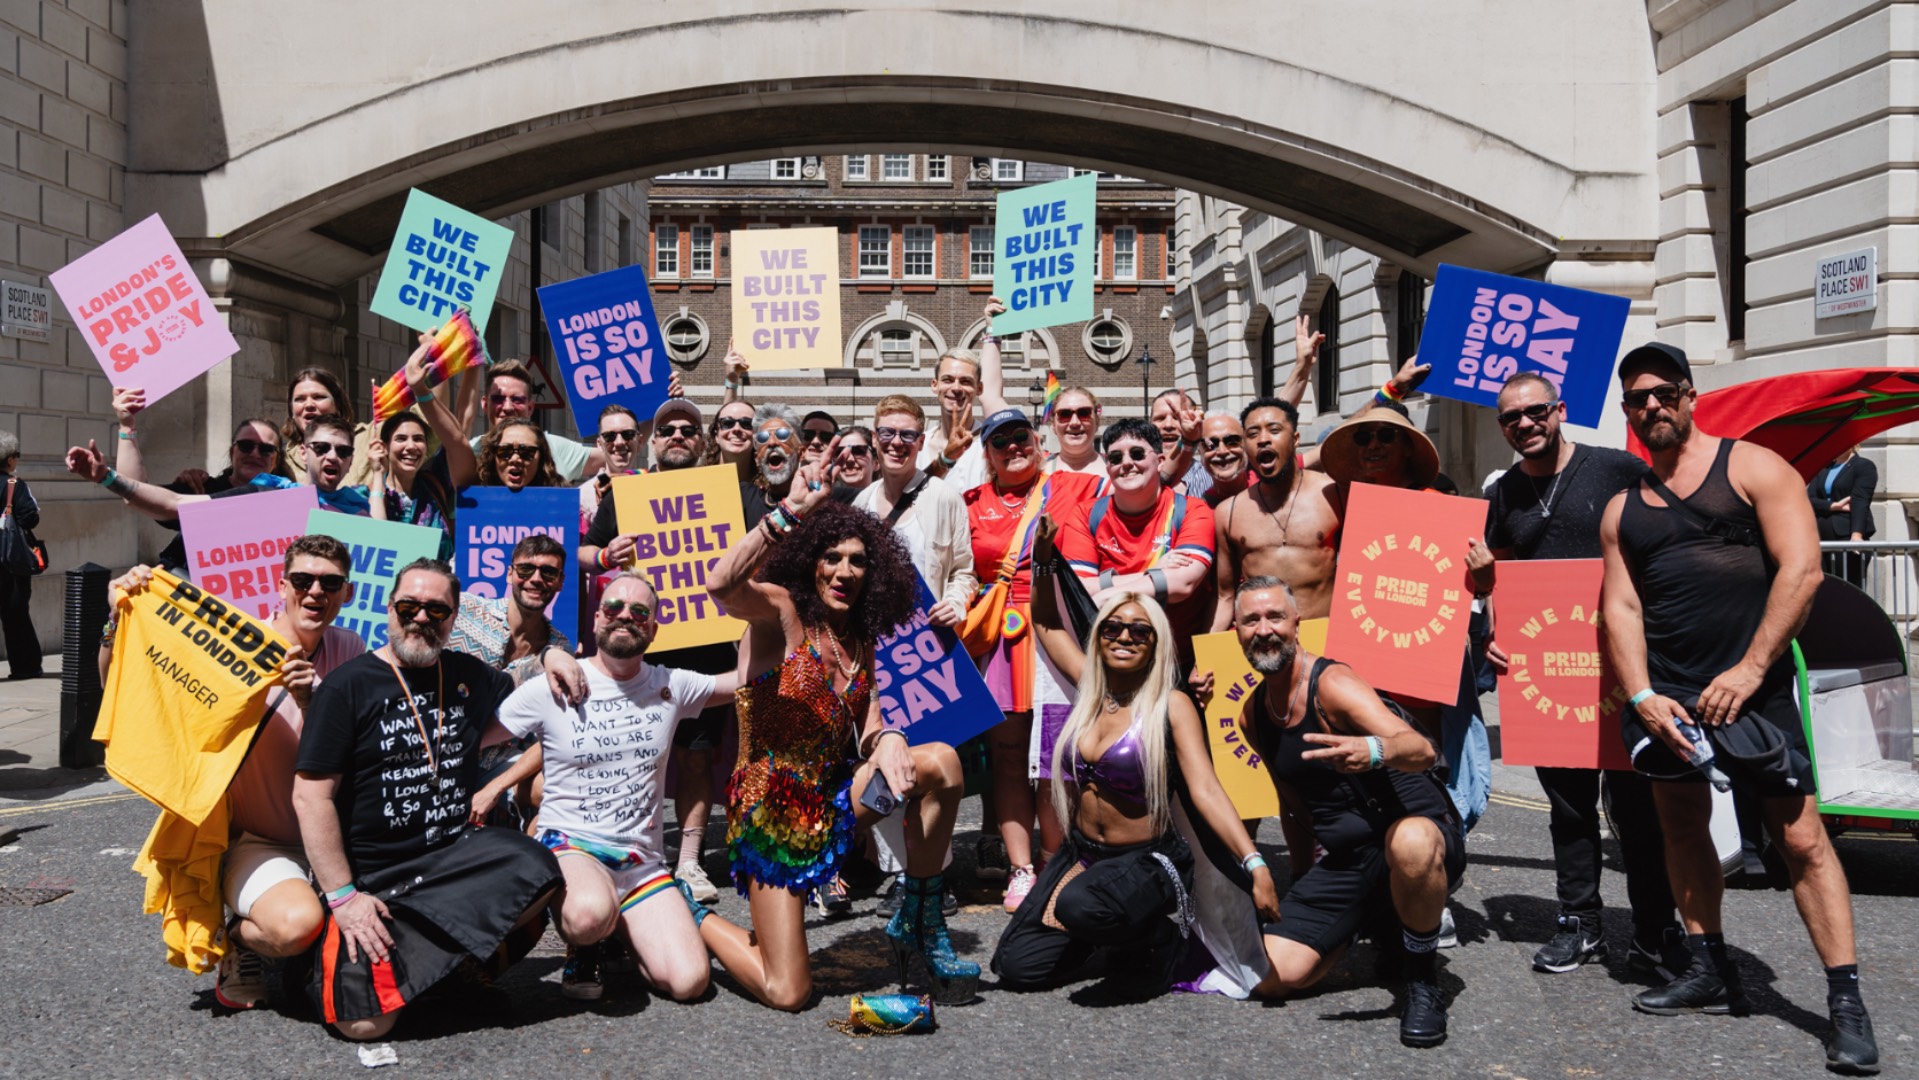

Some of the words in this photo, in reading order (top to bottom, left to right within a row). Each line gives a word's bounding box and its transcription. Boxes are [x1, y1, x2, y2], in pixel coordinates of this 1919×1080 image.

[1023, 200, 1066, 228] WE
[433, 217, 480, 254] WE
[1005, 223, 1083, 258] BU!LT
[405, 233, 491, 282] BU!LT
[760, 248, 808, 270] WE
[1011, 252, 1075, 284] THIS
[1821, 255, 1867, 279] SCOTLAND
[78, 254, 177, 320] LONDON'S
[408, 258, 475, 303] THIS
[743, 274, 827, 297] BU!LT
[1011, 279, 1074, 311] CITY
[1821, 278, 1848, 298] PLACE
[1849, 273, 1869, 293] SW1
[8, 287, 47, 308] SCOTLAND
[89, 272, 194, 347] PR!DE
[751, 300, 820, 323] THIS
[8, 304, 32, 321] PLACE
[32, 309, 48, 325] SW1
[558, 300, 642, 335] LONDON
[1491, 293, 1533, 348] SO
[564, 333, 600, 365] IS
[604, 320, 649, 354] SO
[752, 327, 821, 350] CITY
[1454, 287, 1498, 388] LONDON
[109, 343, 140, 373] &
[573, 348, 654, 400] GAY
[1478, 354, 1518, 393] IS
[649, 493, 707, 524] WE
[635, 523, 731, 560] BU!LT
[1362, 534, 1398, 560] WE
[1407, 535, 1452, 574] ARE
[341, 543, 397, 578] WE
[468, 548, 505, 578] IS
[1374, 589, 1386, 600] IN
[1386, 592, 1428, 608] LONDON
[1376, 575, 1429, 599] PR!DE
[1346, 572, 1460, 648] EVERYWHERE
[1520, 607, 1559, 639] WE
[1570, 604, 1606, 629] AR
[170, 581, 287, 673] PR!DE
[155, 601, 185, 626] IN
[181, 620, 262, 687] LONDON
[891, 630, 945, 676] SO
[1543, 652, 1603, 668] PR!DE
[1544, 668, 1556, 677] IN
[1558, 667, 1604, 677] LONDON
[145, 645, 219, 710] MANAGER
[1225, 672, 1258, 702] WE
[397, 691, 435, 711] JUST
[590, 699, 631, 712] JUST
[879, 658, 963, 731] GAY
[380, 737, 396, 751] IF
[402, 732, 426, 747] YOU
[433, 724, 458, 740] ARE
[572, 718, 615, 733] WANT
[646, 712, 663, 724] SAY
[383, 749, 429, 762] TRANS
[441, 742, 463, 754] AND
[572, 738, 585, 749] IF
[594, 735, 620, 748] YOU
[626, 730, 653, 744] ARE
[574, 751, 623, 765] TRANS
[633, 748, 659, 759] AND
[577, 768, 630, 780] READING
[588, 786, 621, 795] LOVE
[627, 782, 646, 795] YOU
[382, 787, 387, 798] I
[395, 783, 429, 798] LOVE
[383, 802, 395, 817] &
[390, 814, 411, 829] MY
[425, 803, 466, 823] MATES
[583, 813, 600, 824] MY
